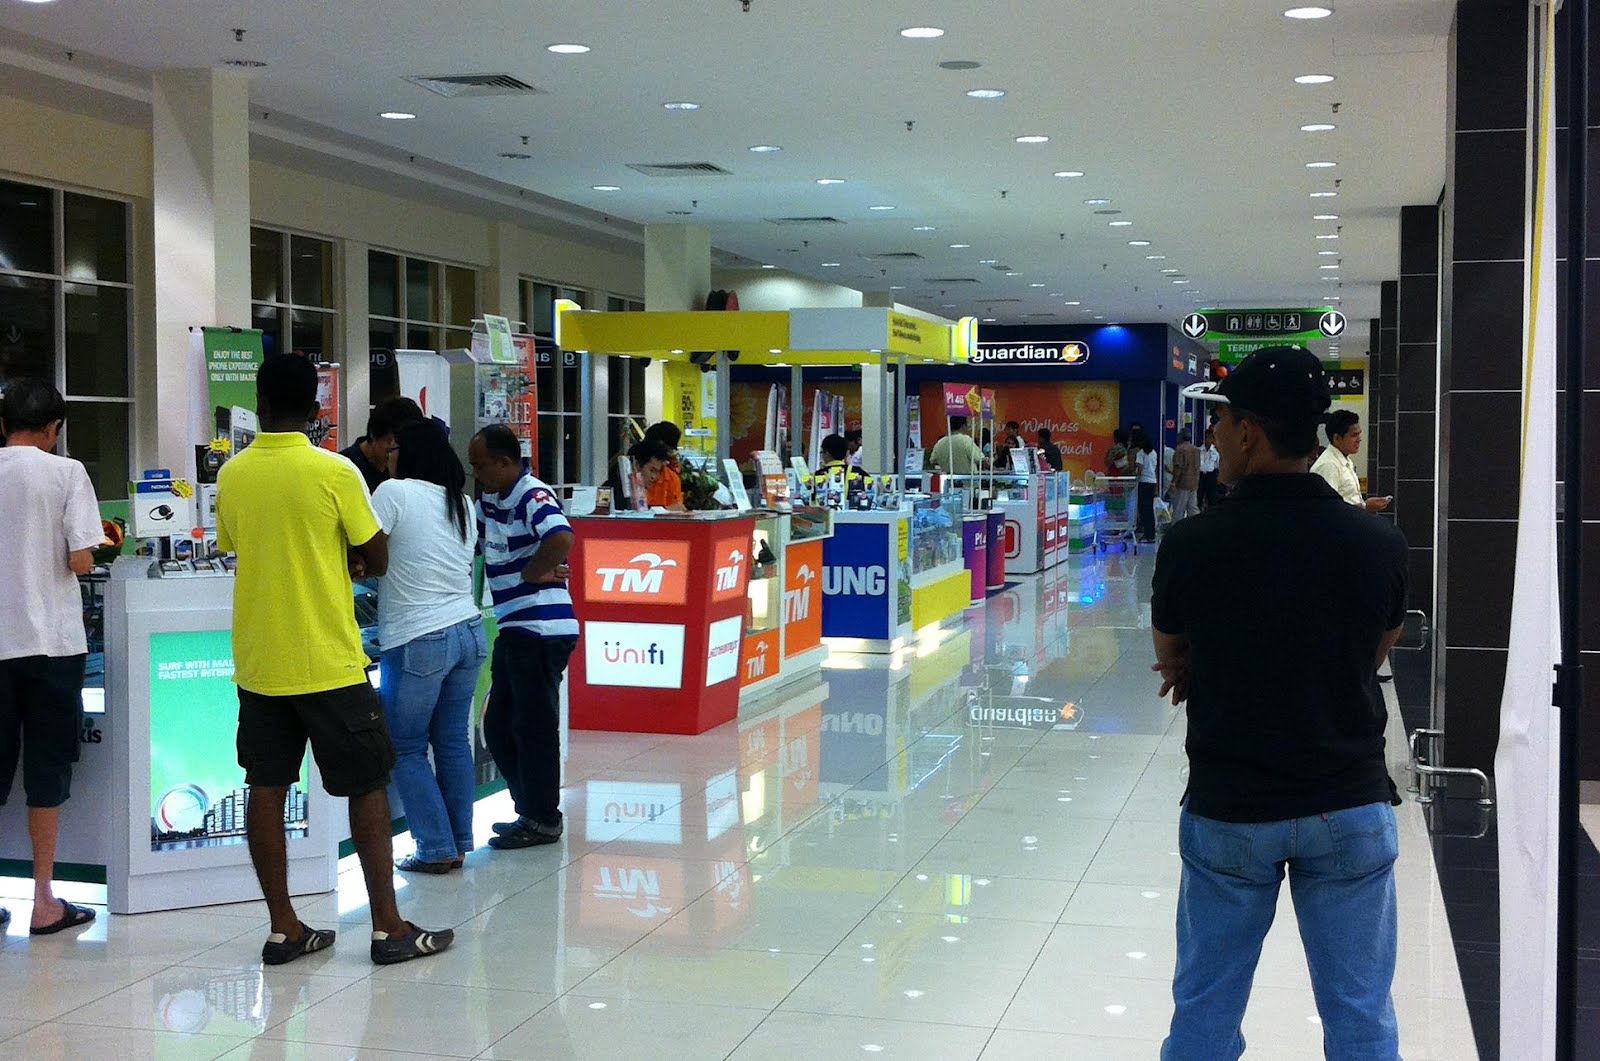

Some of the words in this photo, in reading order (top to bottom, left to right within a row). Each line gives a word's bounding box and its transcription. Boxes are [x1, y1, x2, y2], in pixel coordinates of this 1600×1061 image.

[213, 350, 230, 359] ENJOY
[231, 350, 240, 359] THE
[241, 350, 253, 359] BEST
[972, 344, 1058, 363] guardian
[1227, 343, 1262, 353] TERIMA
[228, 361, 259, 370] EXPERIENCE
[211, 373, 224, 381] ONLY
[225, 373, 239, 381] WITH
[1021, 417, 1079, 433] Wellness
[596, 567, 664, 594] TM
[716, 565, 740, 592] TM
[822, 564, 886, 596] UNG
[784, 586, 810, 624] TM
[158, 661, 184, 671] SURF
[185, 660, 210, 670] WITH
[747, 653, 766, 680] TM
[158, 669, 199, 680] FASTEST
